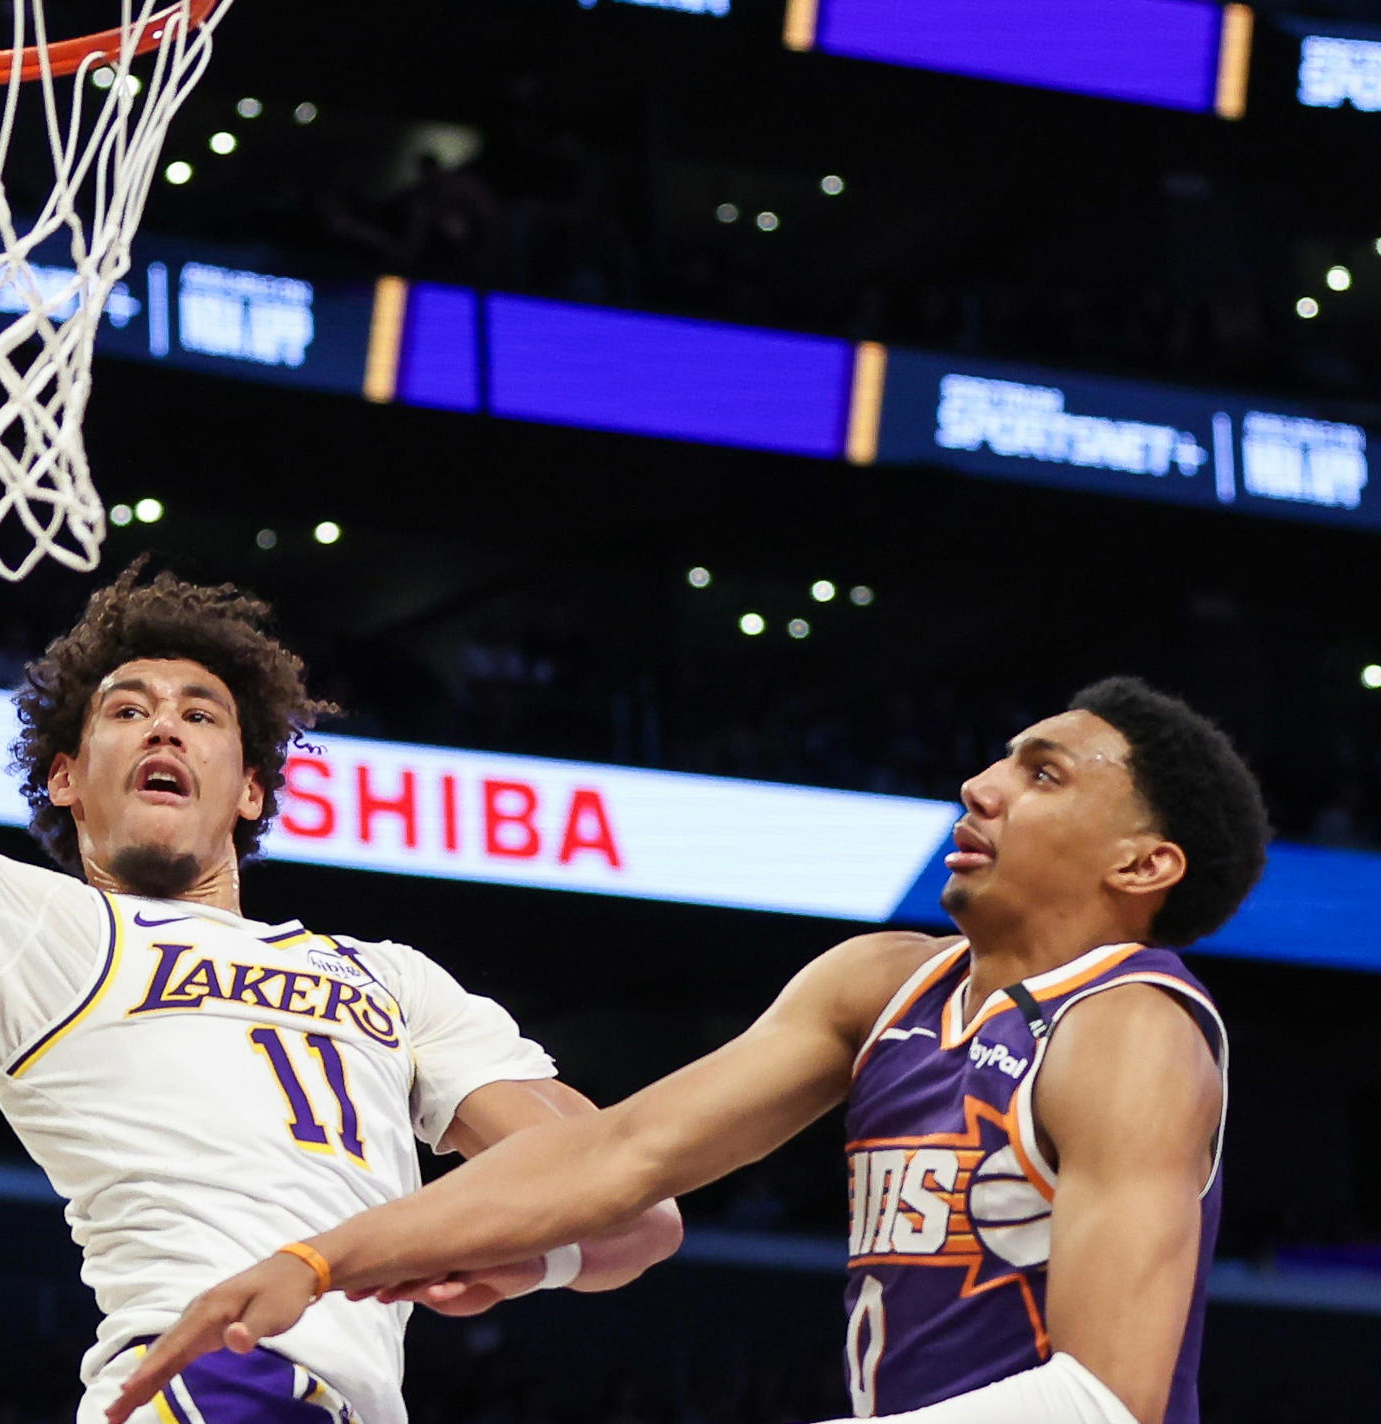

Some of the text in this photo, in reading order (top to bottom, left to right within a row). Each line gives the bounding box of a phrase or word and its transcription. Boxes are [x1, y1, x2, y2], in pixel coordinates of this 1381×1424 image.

[280, 756, 622, 870] SHIBA
[125, 942, 400, 1050] LAKERS
[247, 1023, 371, 1172] 11
